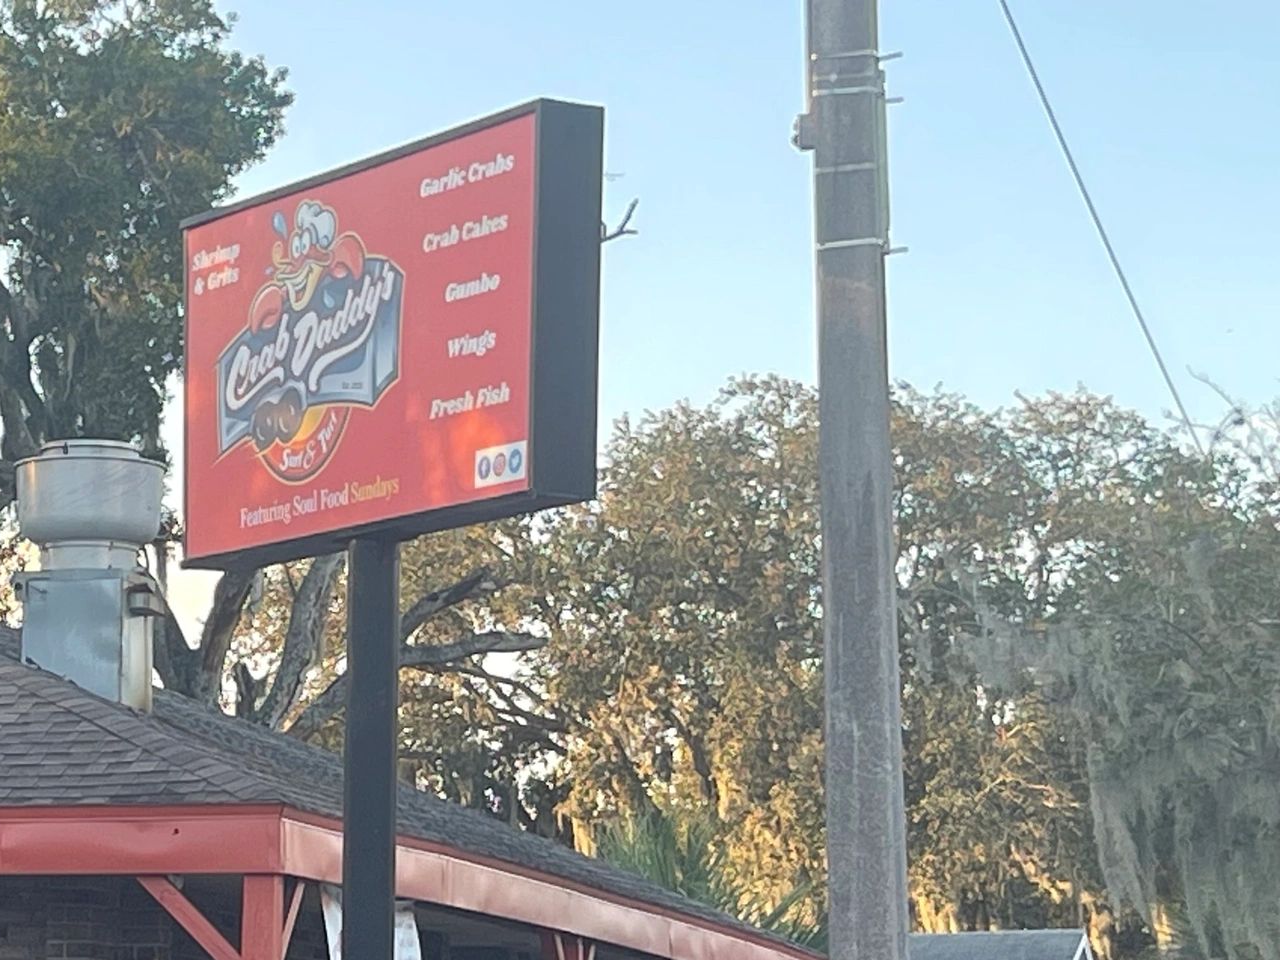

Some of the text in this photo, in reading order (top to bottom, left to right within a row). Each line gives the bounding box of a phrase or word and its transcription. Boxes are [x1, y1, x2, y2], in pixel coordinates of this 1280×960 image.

[420, 153, 514, 198] Garlic Crabs
[423, 215, 508, 253] Crab Cakes
[192, 243, 240, 271] Shrimp
[194, 264, 240, 296] & Grits
[445, 273, 500, 302] Gumbo
[226, 263, 394, 410] Crab Daddy's
[429, 382, 510, 420] Fresh Fish
[303, 440, 317, 470] &
[240, 475, 399, 528] Featuring Soul Food Sundays
